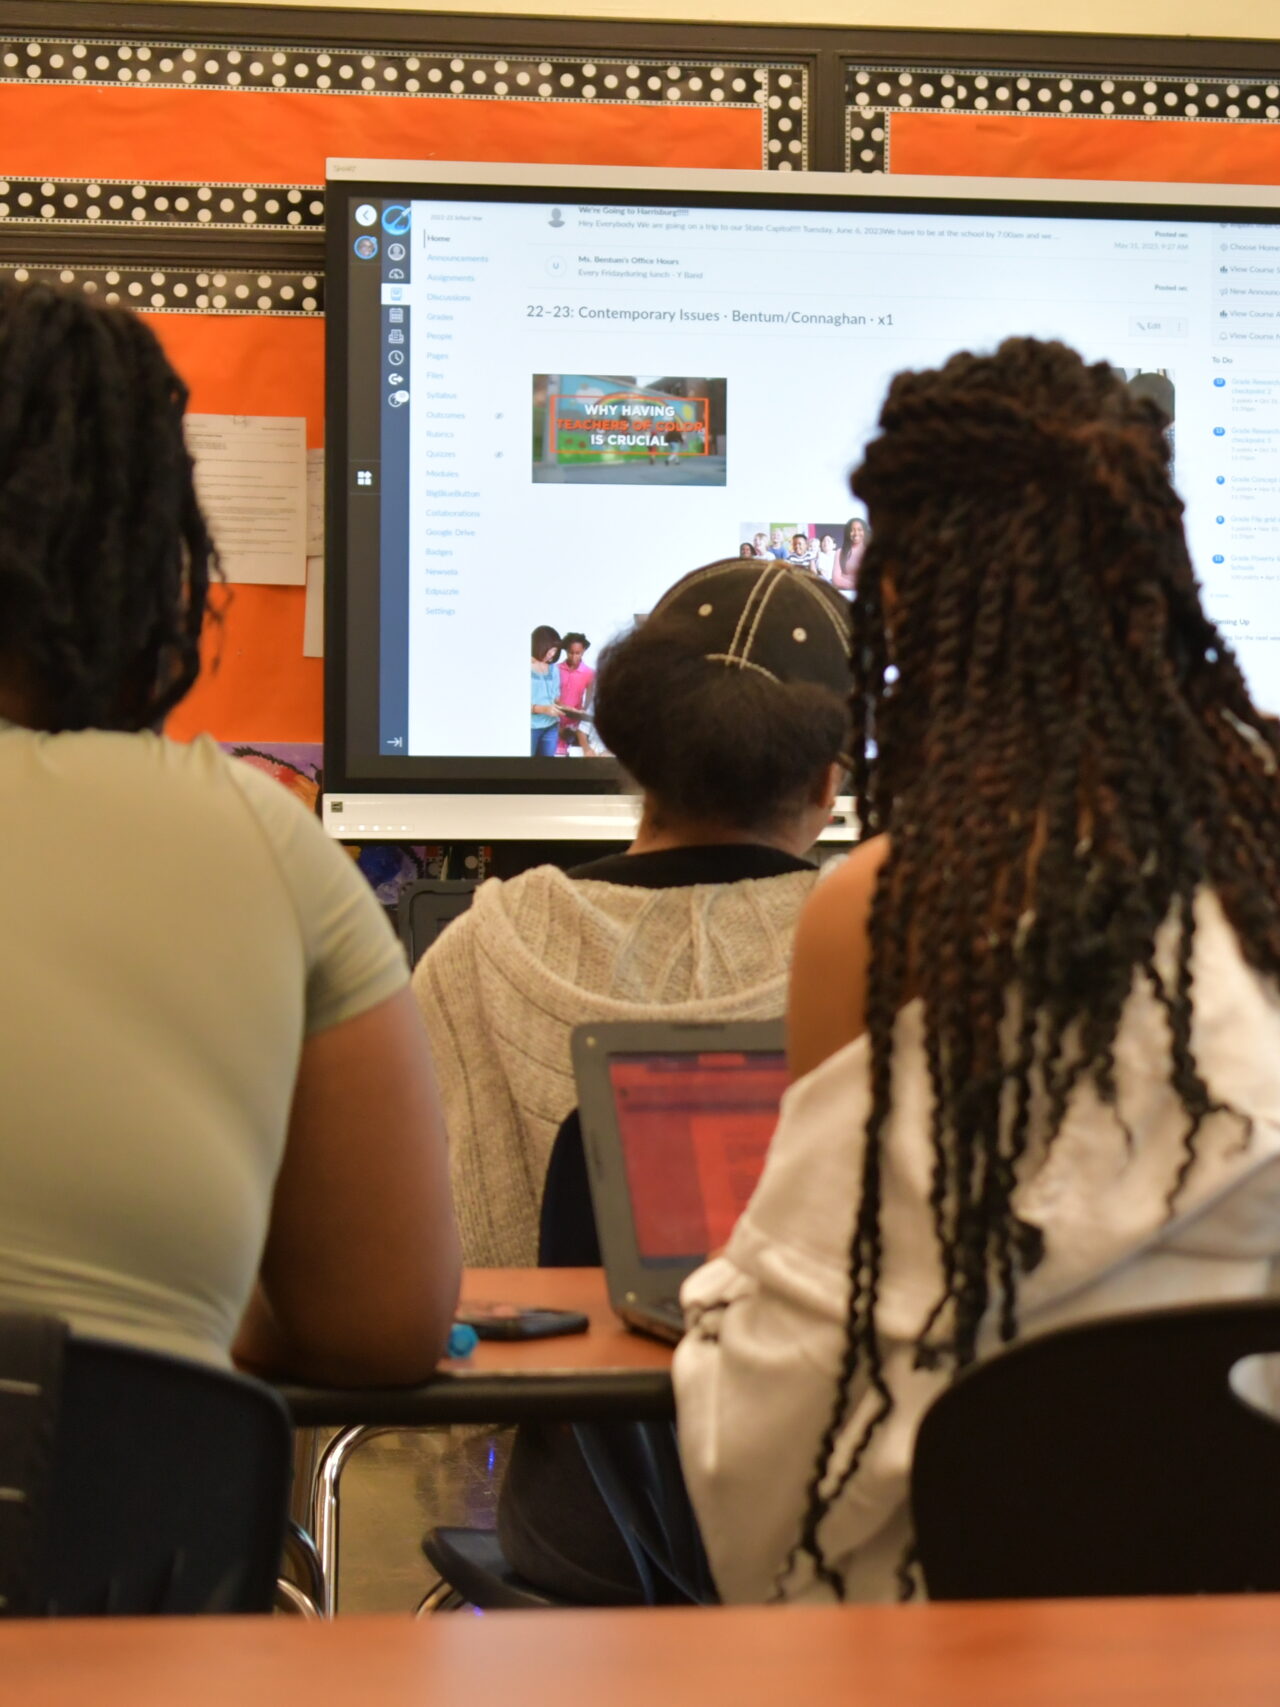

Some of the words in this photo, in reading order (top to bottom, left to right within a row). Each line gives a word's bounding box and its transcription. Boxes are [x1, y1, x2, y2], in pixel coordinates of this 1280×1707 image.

[602, 207, 625, 216] Going
[578, 220, 593, 228] Hey
[595, 220, 635, 229] Everybody
[665, 223, 686, 231] going
[705, 223, 719, 232] trip
[960, 230, 985, 238] school
[986, 231, 996, 240] by
[427, 234, 450, 242] Home
[1230, 243, 1257, 251] Choose
[427, 254, 489, 262] Announcements
[656, 257, 679, 265] Hours
[427, 273, 475, 282] Assignments
[578, 269, 599, 277] Every
[649, 270, 670, 278] lunch
[426, 293, 471, 301] Discussions
[426, 313, 454, 321] Grades
[578, 306, 676, 322] Contemporary
[680, 308, 720, 321] Issues
[731, 310, 866, 326] Bentum/Connaghan
[877, 314, 894, 326] x1
[1249, 310, 1274, 318] Course
[426, 332, 453, 341] People
[1248, 332, 1273, 340] Course
[426, 352, 449, 361] Pages
[426, 371, 444, 379] Files
[426, 392, 457, 400] Syllabus
[426, 411, 466, 419] Outcomes
[584, 404, 617, 416] WHY
[621, 405, 675, 417] HAVING
[557, 419, 629, 432] TEACHERS
[633, 420, 653, 432] OF
[655, 420, 704, 433] COLOR
[590, 434, 603, 445] IS
[607, 434, 669, 446] CRUCIAL
[426, 450, 456, 459] Quizzes
[426, 470, 459, 478] Modules
[425, 509, 481, 517] Collaborations
[425, 528, 453, 537] Google
[455, 528, 476, 536] Drive
[425, 548, 453, 557] Badges
[425, 587, 460, 596] Edpuzzle
[425, 607, 455, 616] Settings
